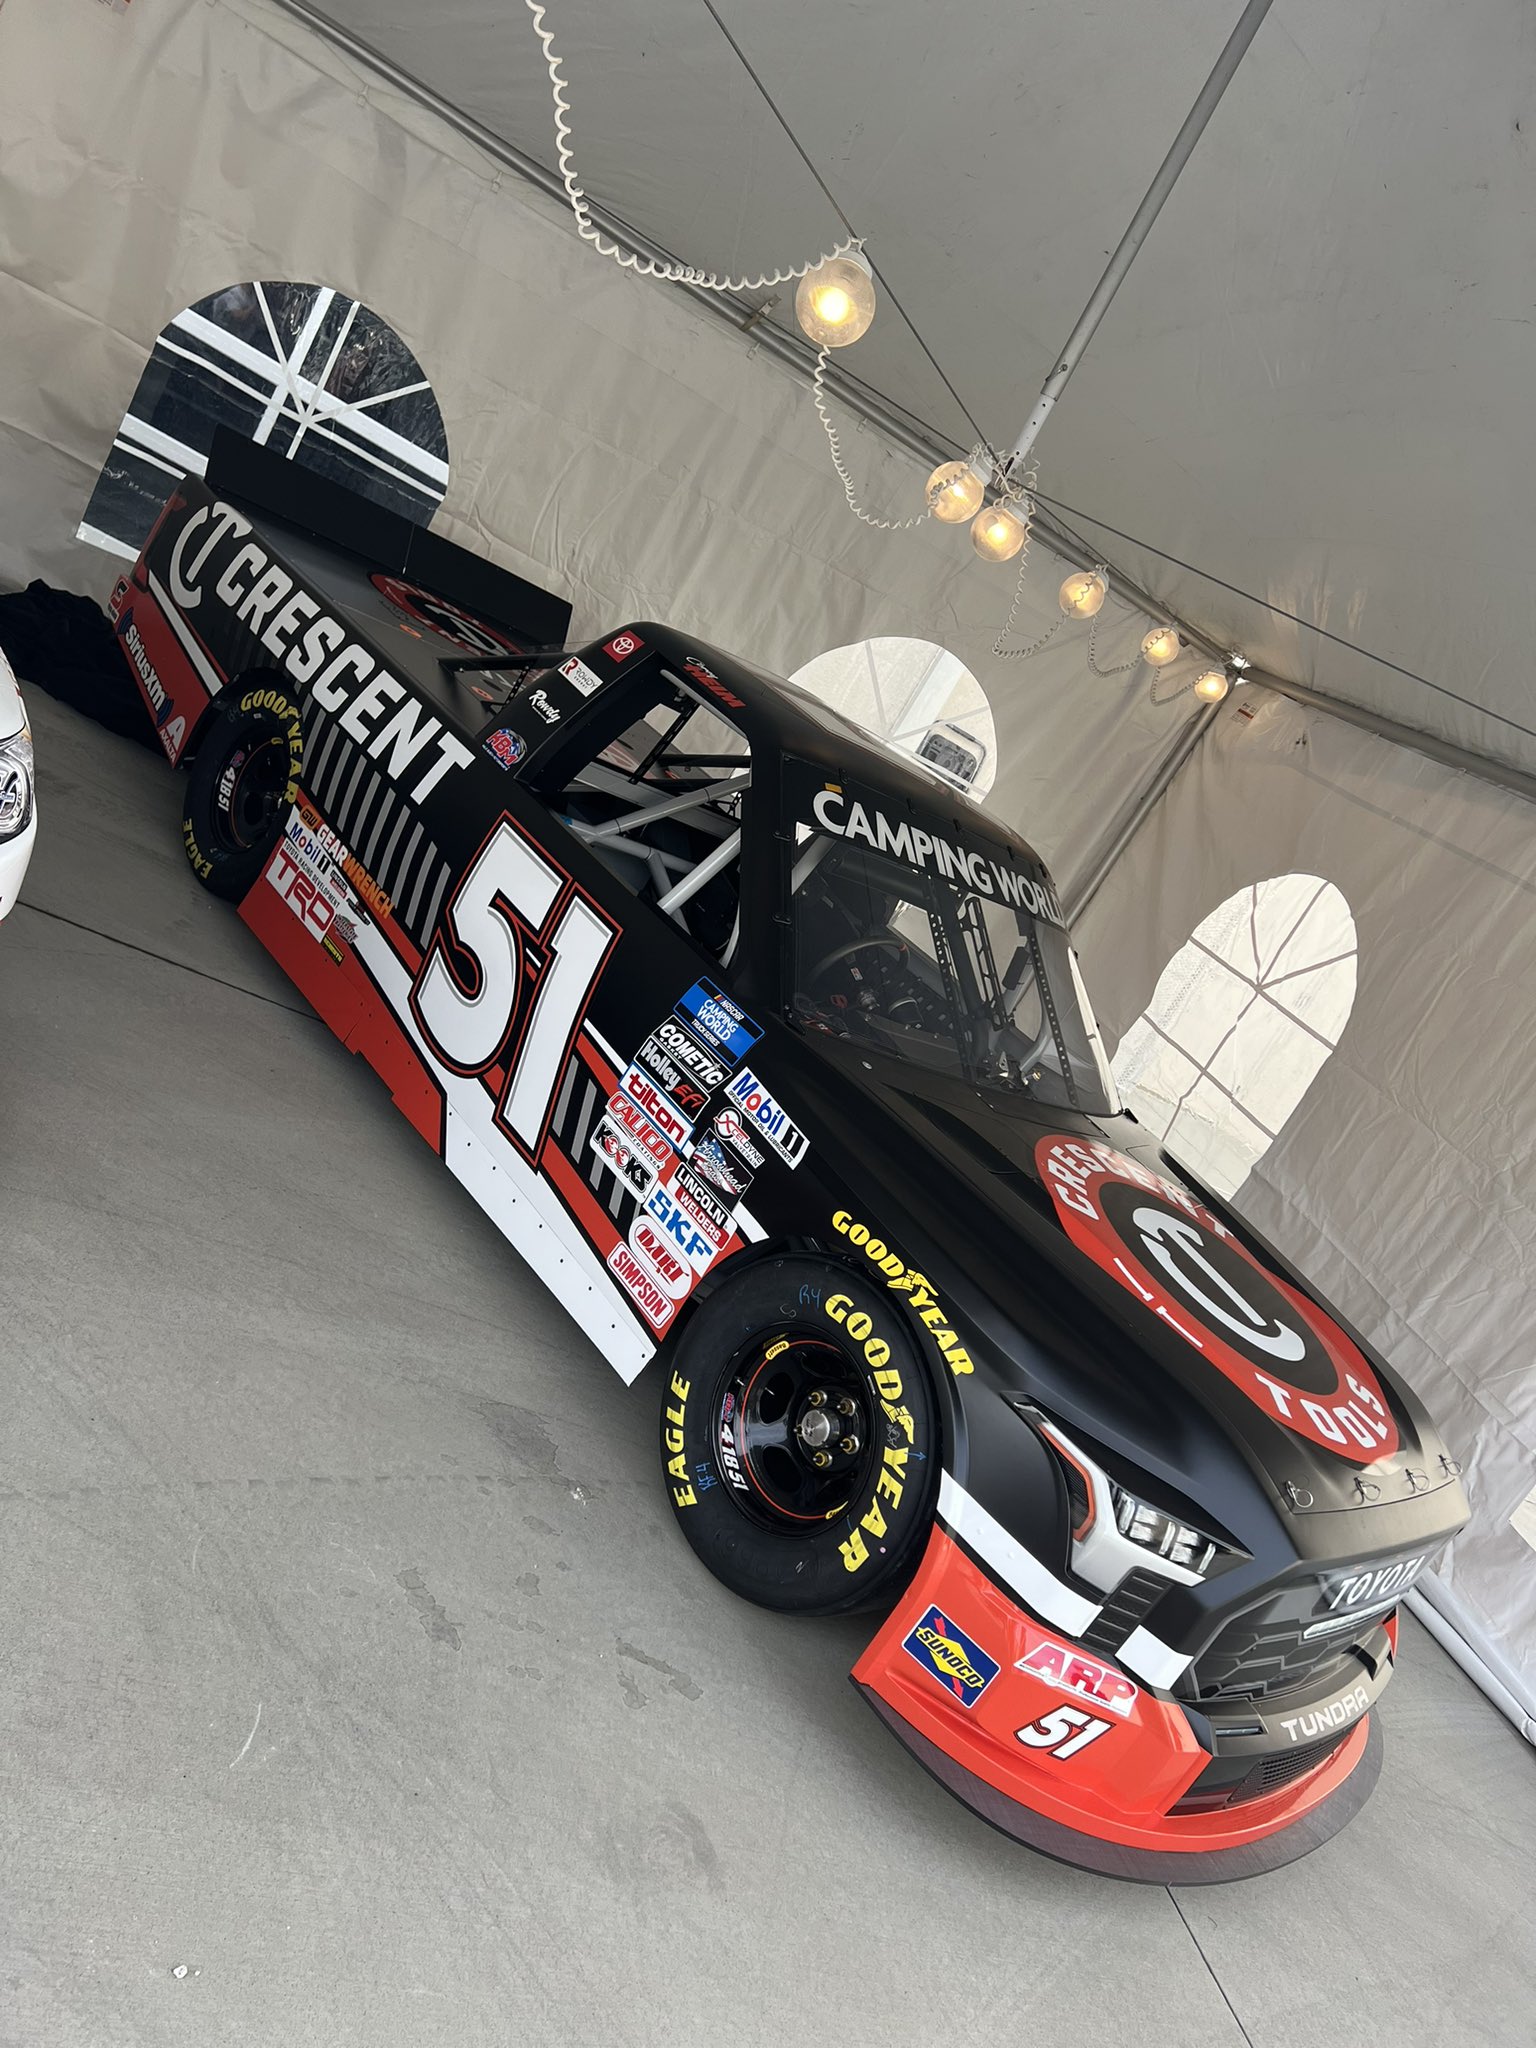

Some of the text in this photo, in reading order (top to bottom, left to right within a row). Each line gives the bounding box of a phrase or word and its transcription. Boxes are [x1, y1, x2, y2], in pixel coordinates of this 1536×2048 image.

[215, 544, 475, 804] CRESCENT
[529, 689, 561, 724] Rowdy
[241, 689, 303, 804] GOODYEAR
[486, 728, 518, 766] KBM
[289, 822, 321, 864] Mobil
[301, 809, 317, 826] GW
[813, 790, 994, 894] CAMPING
[183, 818, 213, 879] EAGLE
[284, 841, 299, 861] TOYOTA
[312, 873, 340, 909] DEVELOPMENT
[316, 824, 394, 919] GEARWRENCH
[277, 847, 336, 931] TRD
[414, 815, 618, 1160] 51
[704, 999, 739, 1034] CAMPING
[719, 1000, 745, 1021] NASCAR
[691, 1019, 721, 1047] TRUCK SERIES
[696, 1006, 732, 1041] WORLD
[640, 1040, 681, 1092] Holley
[660, 1024, 724, 1085] COMETIC
[608, 1094, 672, 1161] CALICO
[628, 1073, 685, 1143] tilton
[728, 1090, 743, 1108] OFFICIAL
[743, 1108, 759, 1125] MOTOR
[767, 1134, 793, 1163] LUBRICANTS
[732, 1072, 785, 1136] Mobil
[676, 1168, 725, 1224] LINCOLN
[696, 1141, 747, 1193] Arrowhead
[648, 1189, 713, 1256] SKF
[680, 1191, 721, 1243] WELDERS
[613, 1250, 668, 1318] SIMPSON
[832, 1210, 975, 1376] GOODYEAR
[666, 1370, 698, 1507] EAGLE
[825, 1293, 915, 1573] GOODYEAR
[1254, 1373, 1388, 1448] TOOLS
[1328, 1555, 1425, 1610] TOYOTA
[918, 1630, 982, 1685] SUNOCO
[1022, 1644, 1136, 1703] ARP
[1013, 1702, 1116, 1761] 51
[1281, 1685, 1370, 1742] TUNDRA
